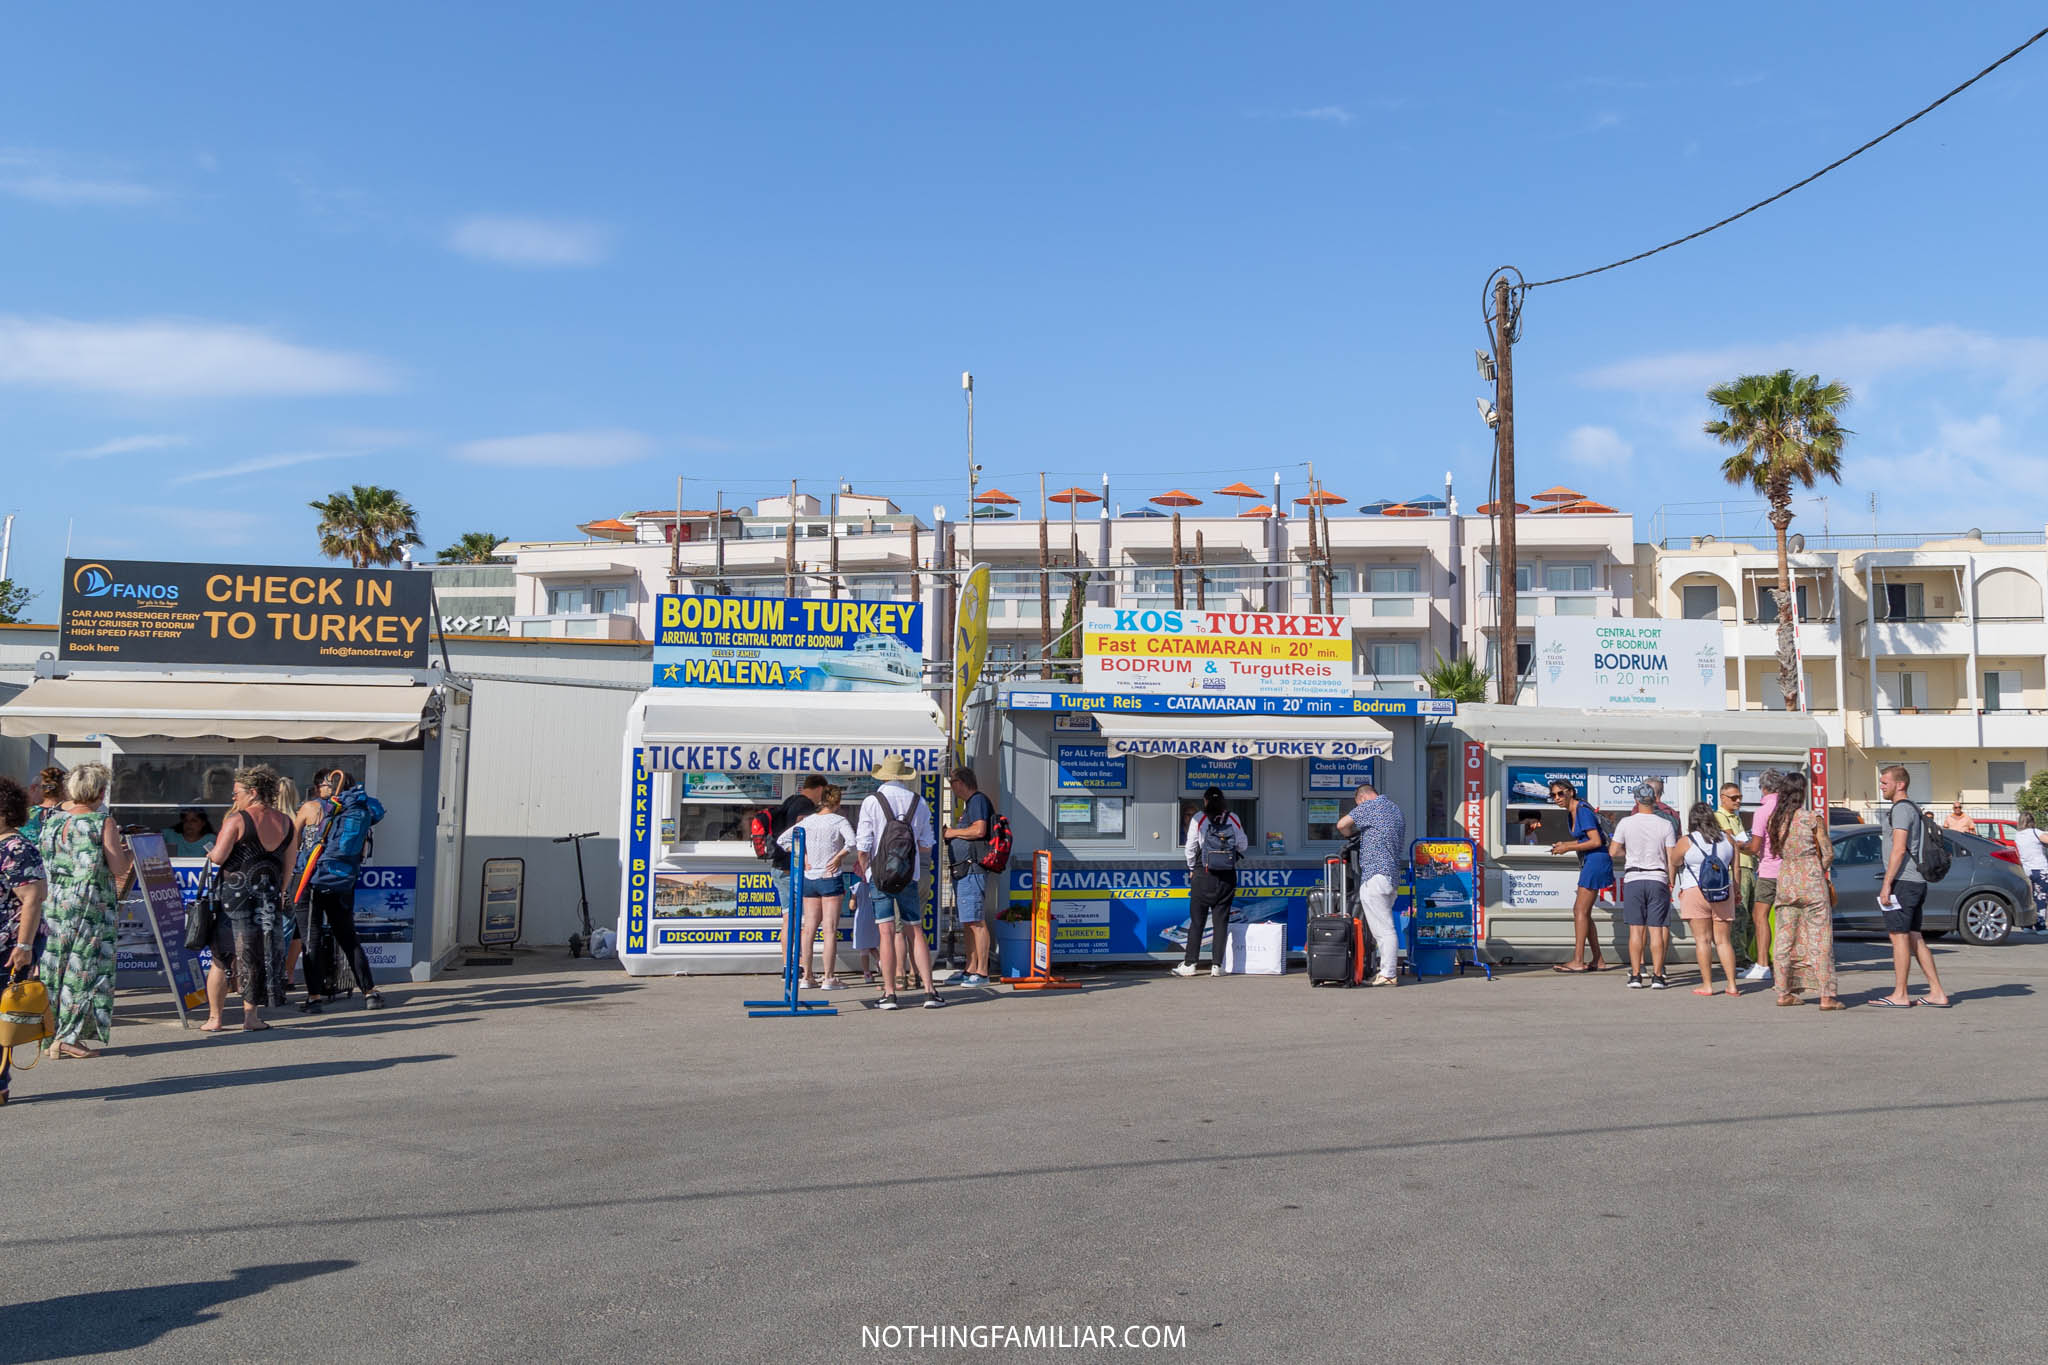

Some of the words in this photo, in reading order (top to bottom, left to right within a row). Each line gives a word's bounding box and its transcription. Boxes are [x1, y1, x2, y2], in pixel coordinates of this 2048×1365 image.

[113, 583, 179, 600] FANOS
[206, 574, 343, 605] CHECK
[355, 579, 392, 607] IN
[72, 610, 92, 618] CAR
[115, 611, 169, 620] PASSENGER
[171, 612, 200, 621] FERRY
[662, 597, 784, 631] BODRUM
[802, 601, 916, 634] TURKEY
[72, 619, 97, 627] DAILY
[98, 620, 139, 628] CRUISER
[155, 621, 195, 629] BODRUM
[203, 611, 256, 639] TO
[266, 612, 423, 644] TURKEY
[441, 615, 510, 632] KOSTA
[1088, 622, 1112, 630] From
[1114, 610, 1182, 633] KOS
[1196, 625, 1206, 633] To
[1205, 613, 1345, 637] TURKEY
[96, 629, 127, 637] SPEED
[152, 630, 182, 638] FERRY
[1596, 627, 1636, 638] CENTRAL
[1638, 629, 1661, 638] PORT
[661, 631, 699, 645] ARRIVAL
[701, 632, 713, 645] TO
[714, 633, 731, 645] THE
[731, 633, 769, 647] CENTRAL
[771, 635, 794, 647] PORT
[795, 635, 806, 647] OF
[807, 635, 843, 648] BODRUM
[1601, 639, 1614, 649] OF
[1616, 640, 1658, 650] BODRUM
[69, 643, 95, 651] Book
[97, 643, 120, 652] here
[320, 646, 414, 658] info@fanostravel.gr
[736, 650, 760, 658] FAMILY
[1098, 637, 1137, 653] Fast
[1147, 638, 1262, 656] CATAMARAN
[1270, 644, 1280, 654] in
[1289, 642, 1313, 657] 20'
[1317, 648, 1338, 658] min.
[1101, 658, 1192, 672] BODRUM
[1204, 661, 1217, 673] &
[1230, 661, 1331, 678] TurgutReis
[1594, 653, 1668, 670] BODRUM
[684, 660, 784, 684] MALENA
[1595, 672, 1608, 684] in
[1616, 672, 1634, 685] 20
[1642, 673, 1669, 685] min
[1203, 677, 1226, 685] exas
[1059, 694, 1105, 710] Turgut
[1112, 695, 1142, 709] Reis
[1166, 697, 1256, 711] CATAMARAN
[1263, 699, 1275, 711] in
[1282, 698, 1303, 712] 20'
[1307, 700, 1332, 712] min
[1353, 700, 1406, 713] Bodrum
[1060, 749, 1072, 757] For
[1075, 749, 1088, 757] ALL
[1115, 740, 1226, 754] CATAMARAN
[1232, 742, 1249, 754] to
[1255, 742, 1325, 755] TURKEY
[650, 746, 741, 770] TICKETS
[750, 754, 761, 770] &
[767, 747, 873, 771] CHECK-IN
[884, 749, 939, 772] ERE
[1468, 746, 1481, 768] TO
[1812, 752, 1824, 774] TO
[1106, 761, 1125, 769] Turkey
[1208, 761, 1238, 769] TURKEY
[1346, 763, 1368, 771] Office
[1544, 772, 1571, 780] CENTRAL
[1613, 785, 1625, 794] OF
[635, 754, 649, 842] TURKEY
[739, 874, 773, 889] EVERY
[1018, 871, 1171, 888] CTAMARANS
[150, 888, 179, 902] RODON
[738, 892, 750, 903] DEP.
[750, 893, 764, 903] FROM
[764, 893, 775, 903] KOS
[1110, 889, 1170, 898] TICKETS
[1241, 888, 1259, 897] IN
[629, 859, 646, 948] BODRUM
[738, 906, 749, 917] DEP.
[749, 906, 762, 917] FROM
[762, 907, 782, 917] BODRUM
[667, 931, 732, 942] DISCOUNT
[739, 932, 764, 941] FOR
[1065, 929, 1094, 937] TURKEY
[117, 961, 158, 969] BODRUM
